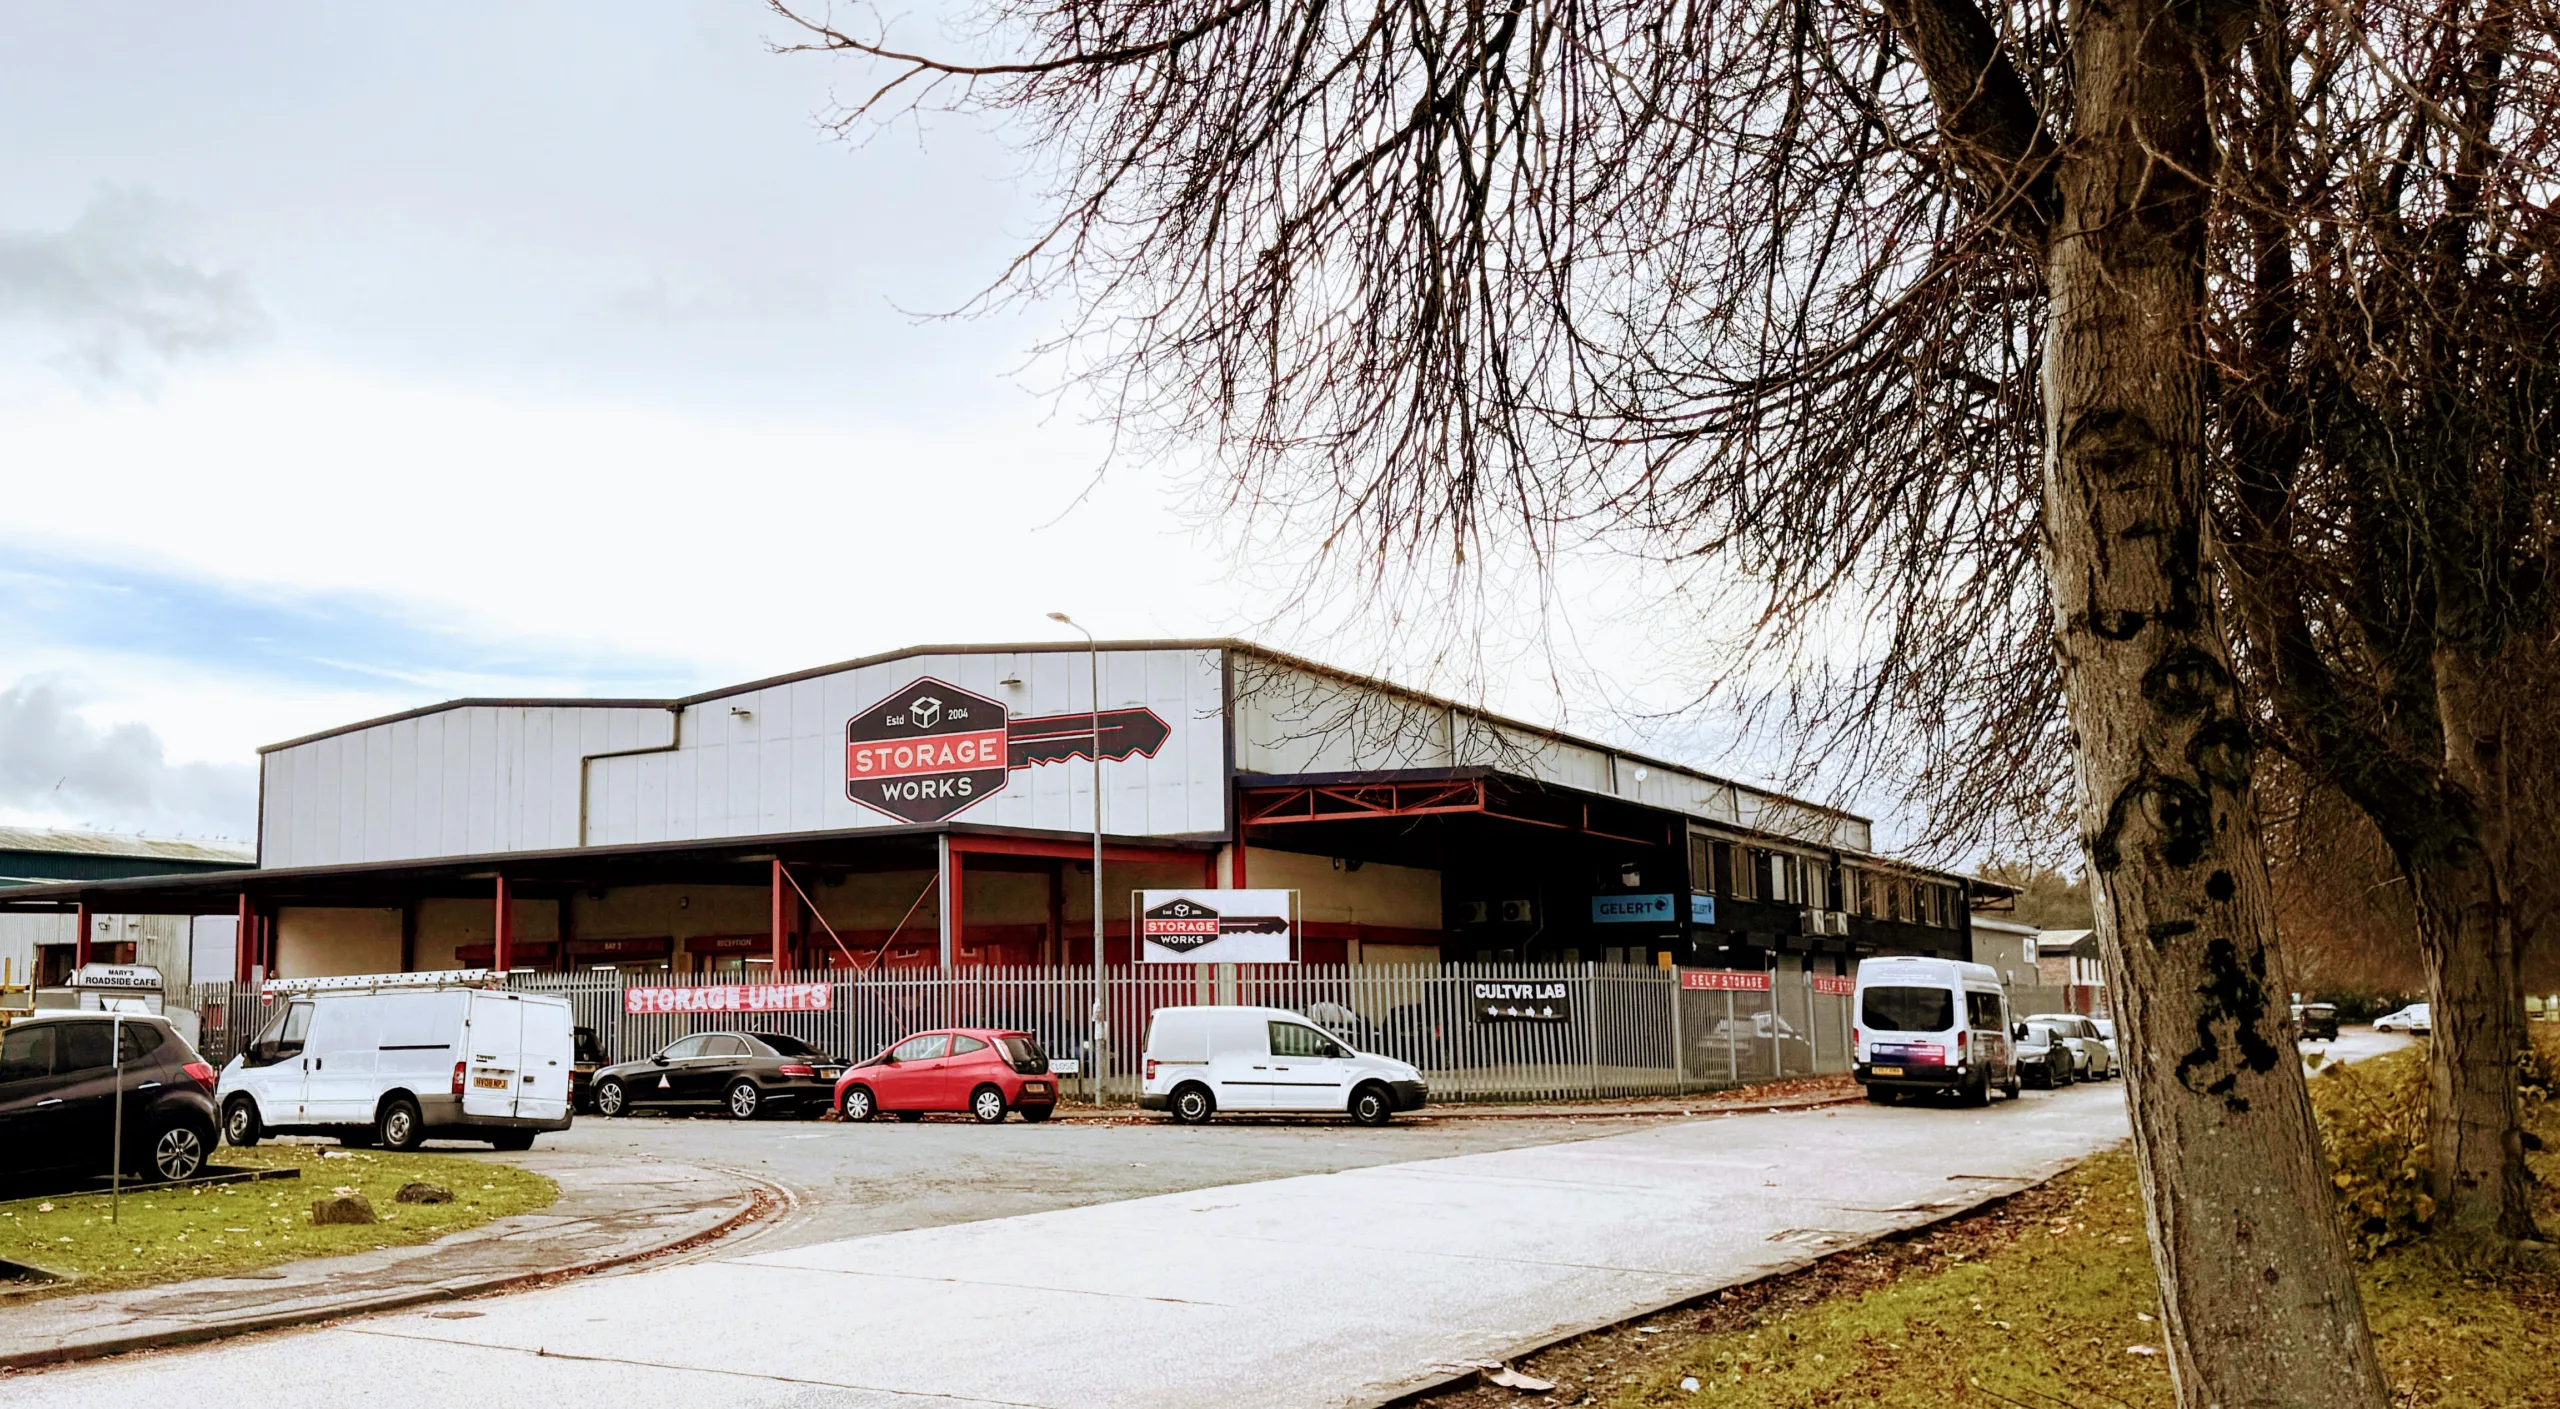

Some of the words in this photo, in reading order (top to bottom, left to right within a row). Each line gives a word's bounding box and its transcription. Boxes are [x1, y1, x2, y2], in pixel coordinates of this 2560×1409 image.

[948, 708, 969, 720] 2004
[886, 715, 905, 726] Estd
[856, 738, 997, 772] STORAGE
[881, 777, 972, 802] WORKS
[1600, 902, 1653, 915] GELERT
[1148, 921, 1215, 932] STORAGE
[716, 938, 752, 947] RECEPTION
[1160, 935, 1204, 944] WORKS
[604, 942, 616, 950] BAY
[85, 976, 131, 986] ROADSIDE
[133, 978, 157, 986] CAFE
[1691, 974, 1717, 987] SELF
[1722, 975, 1762, 988] STORAGE
[1819, 979, 1836, 991] SELF
[1839, 981, 1854, 993] STOR
[1475, 983, 1534, 999] CULTVR
[1535, 983, 1566, 999] LAB
[628, 985, 741, 1011] STORAGE
[750, 984, 827, 1009] UNITS
[1050, 1062, 1075, 1070] CLOSE
